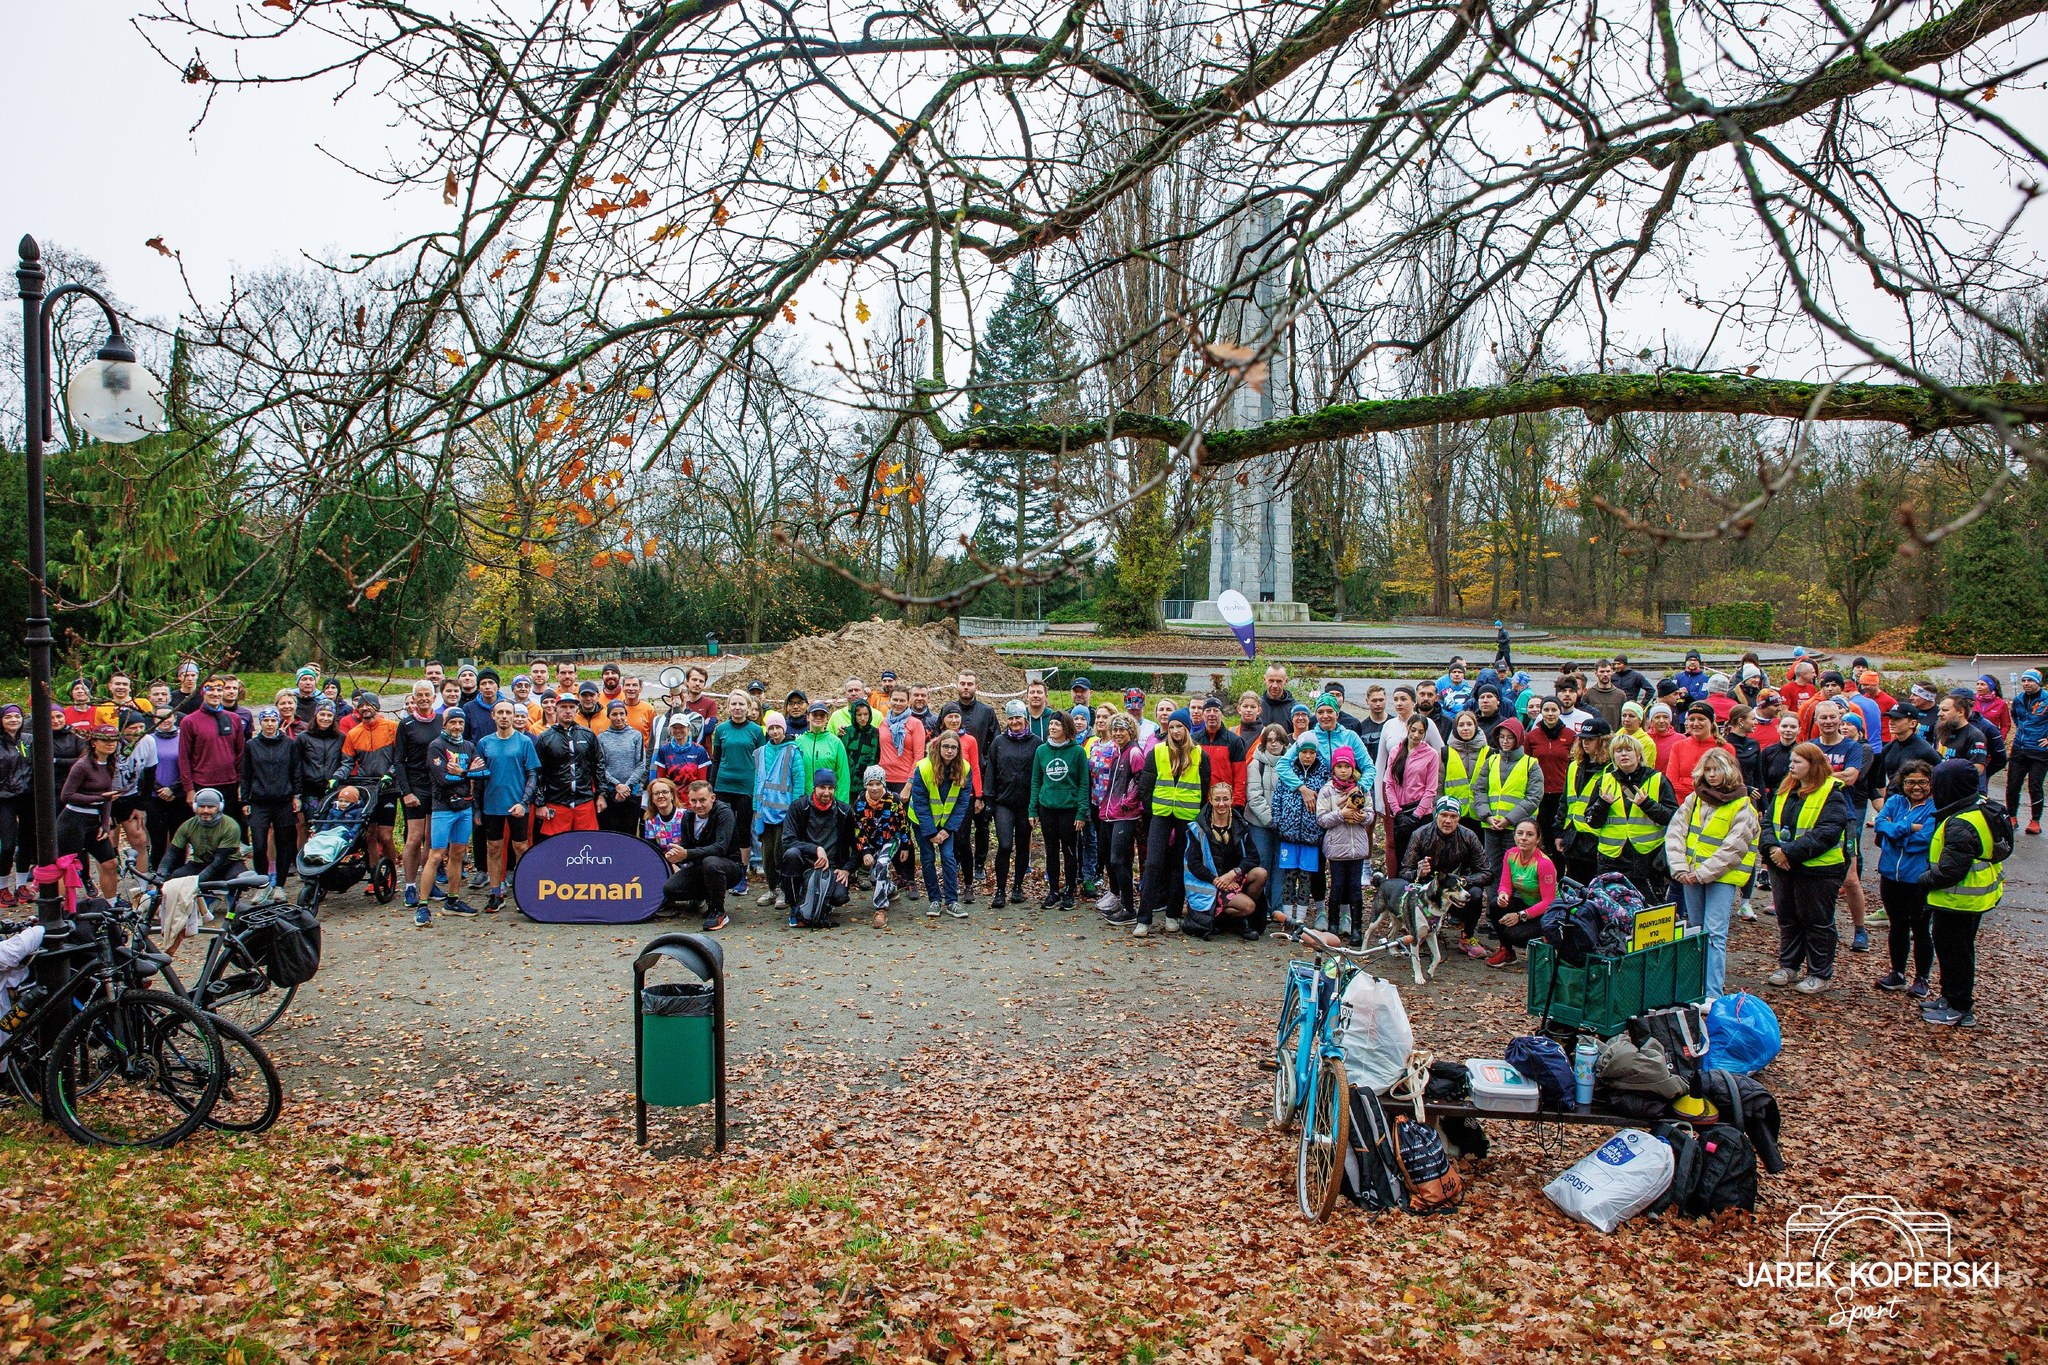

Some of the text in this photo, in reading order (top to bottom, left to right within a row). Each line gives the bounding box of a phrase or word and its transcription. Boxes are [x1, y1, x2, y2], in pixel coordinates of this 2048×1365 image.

[566, 846, 613, 867] parkrun
[538, 877, 643, 901] Poznań
[1637, 916, 1672, 930] DEBIUTANTÓW
[1649, 930, 1660, 938] DLA
[1560, 1173, 1594, 1195] DEPOSIT
